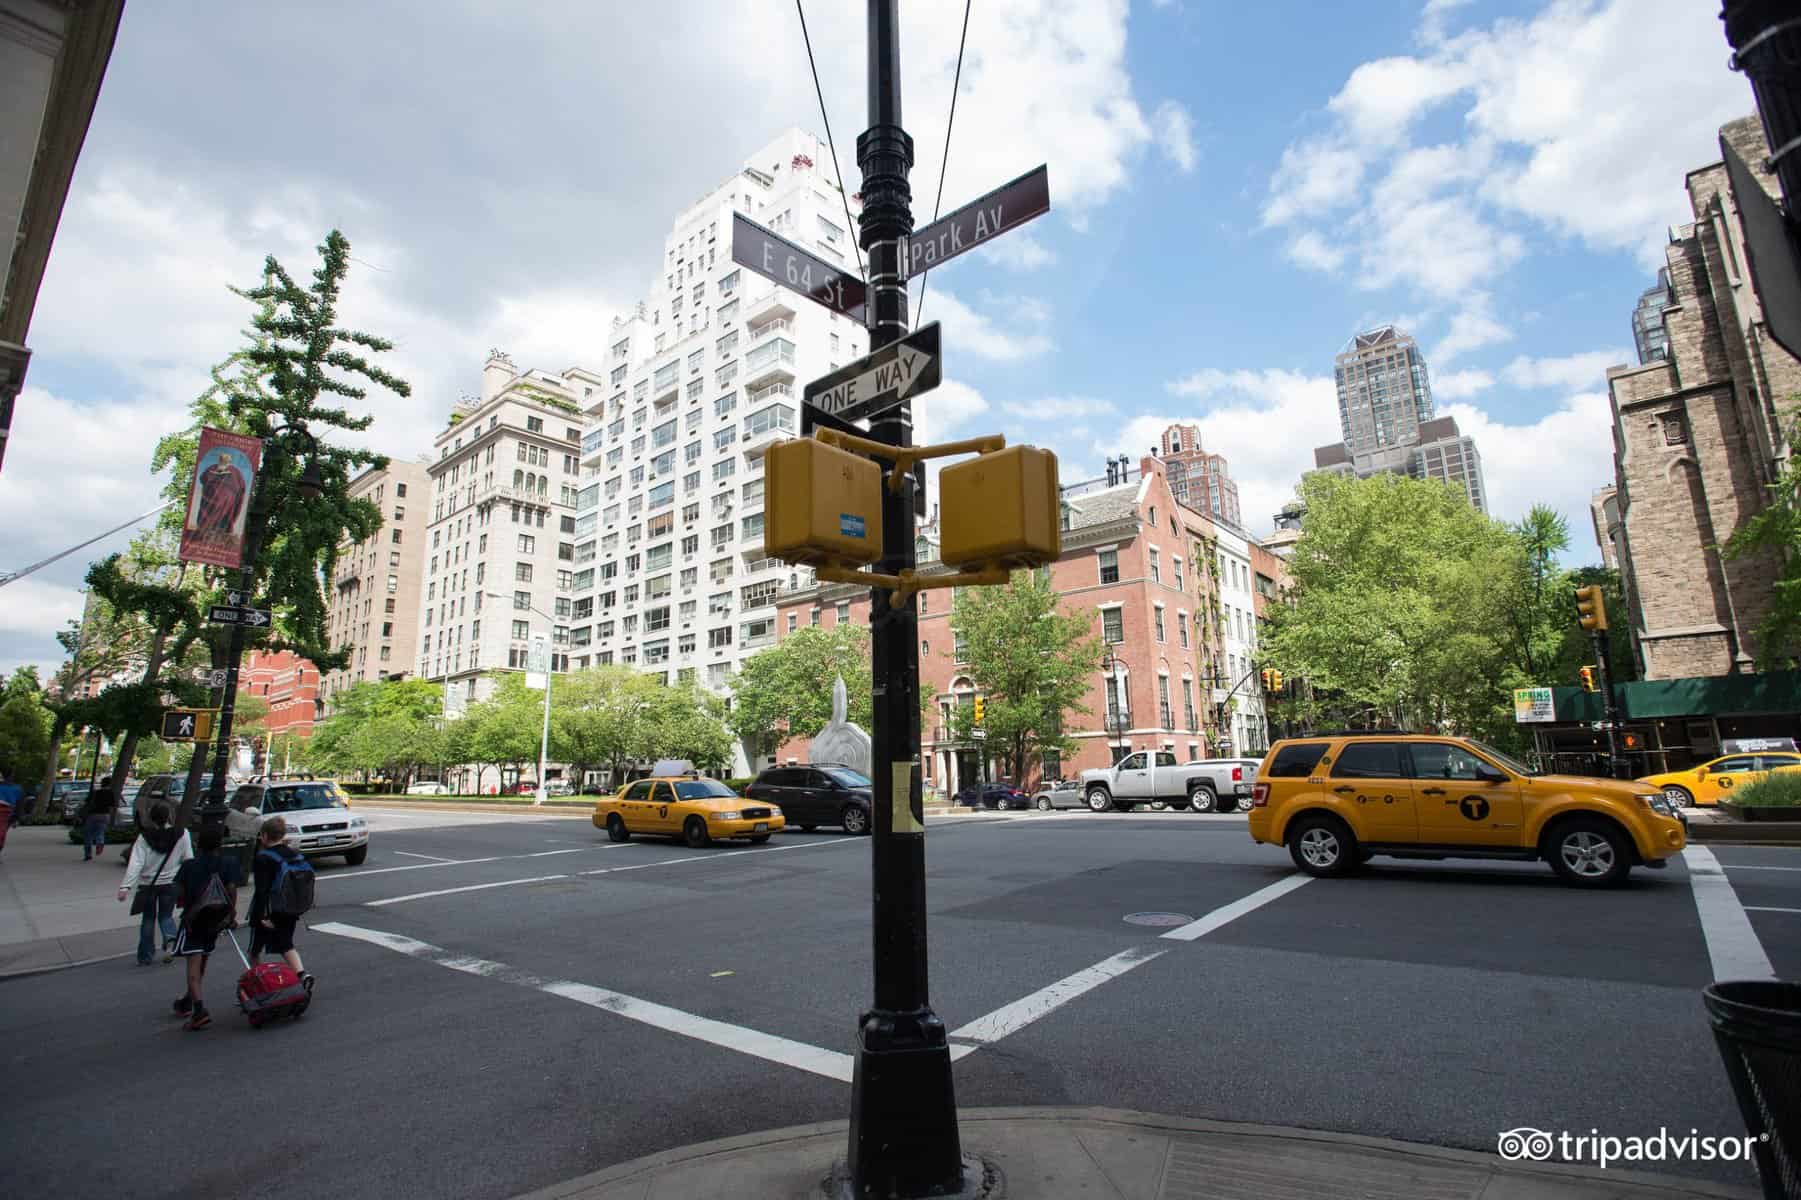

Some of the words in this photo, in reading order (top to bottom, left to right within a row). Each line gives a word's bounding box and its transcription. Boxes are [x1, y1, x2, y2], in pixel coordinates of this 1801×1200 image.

[911, 222, 963, 271] Park
[975, 204, 1003, 240] Av
[763, 240, 774, 273] E
[786, 255, 811, 293] 64
[823, 275, 845, 310] St
[821, 380, 857, 413] ONE
[875, 353, 917, 393] WAY
[1466, 800, 1482, 817] T
